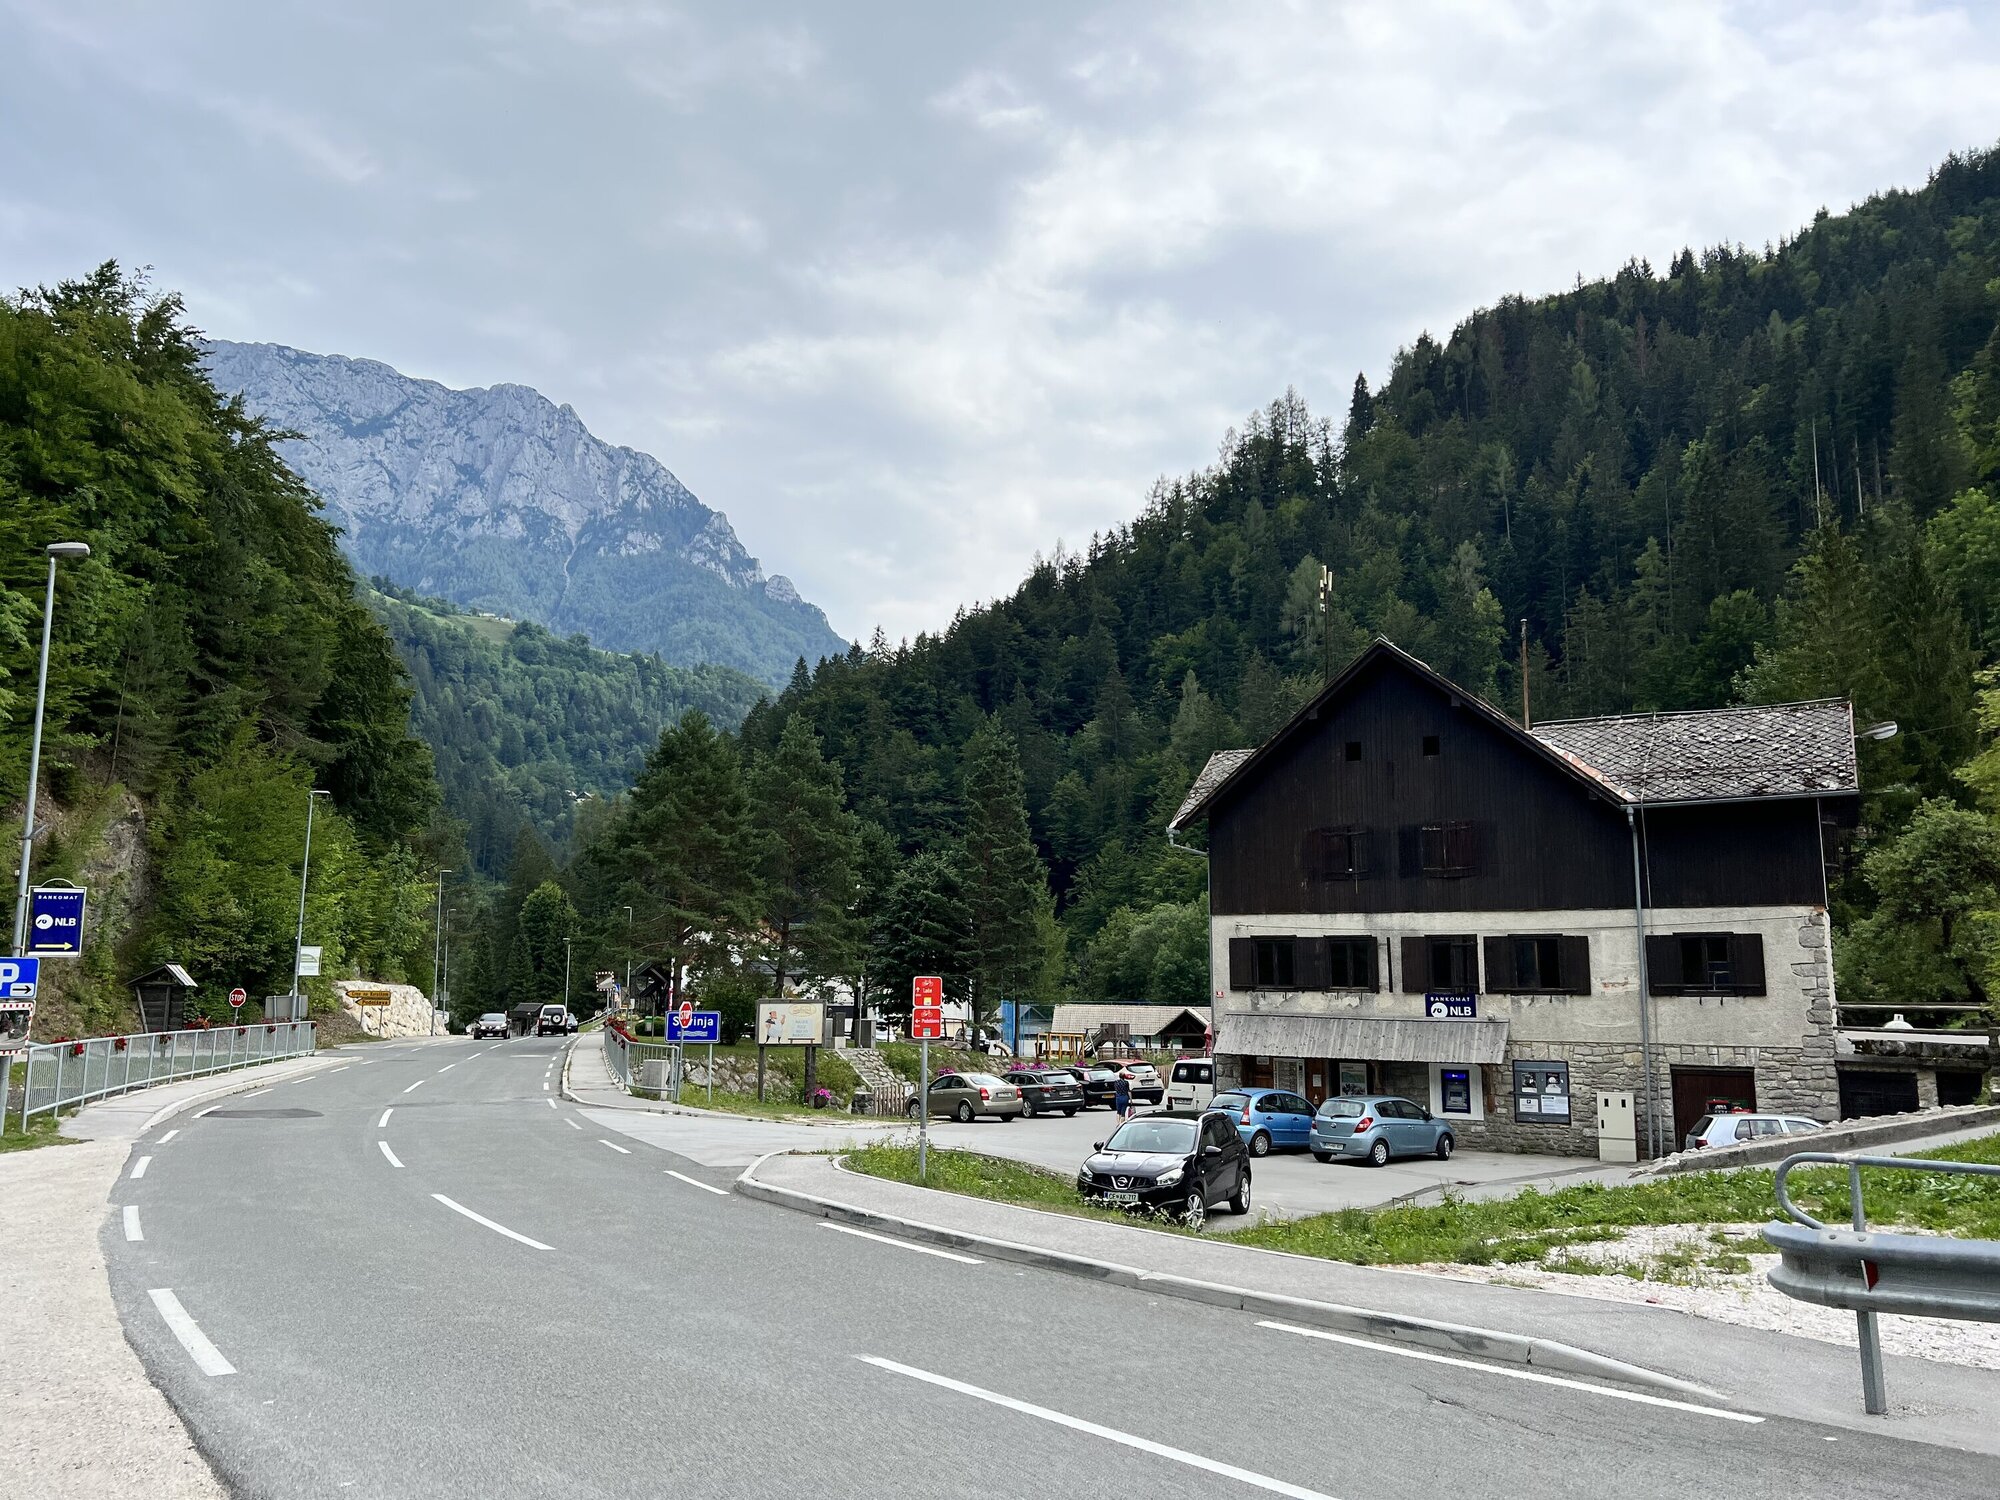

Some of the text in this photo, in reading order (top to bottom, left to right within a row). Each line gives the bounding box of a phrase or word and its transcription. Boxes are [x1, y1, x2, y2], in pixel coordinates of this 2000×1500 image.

[54, 917, 77, 927] NLB
[0, 962, 20, 990] P
[680, 1010, 692, 1020] STOP
[1450, 1006, 1472, 1016] NLB
